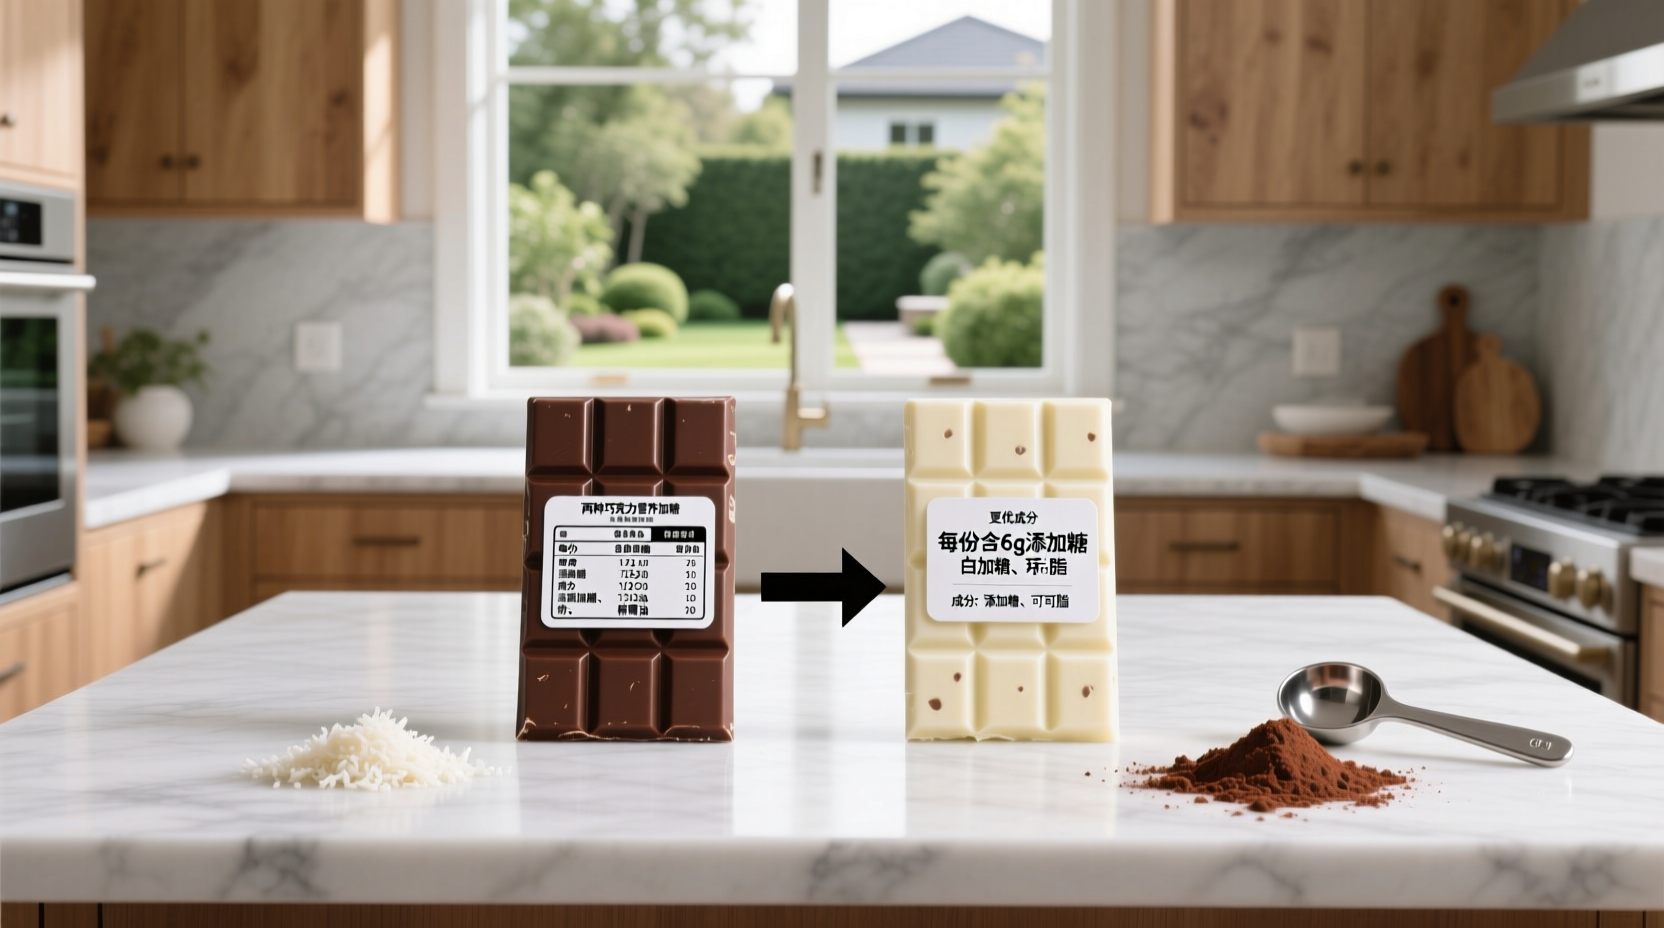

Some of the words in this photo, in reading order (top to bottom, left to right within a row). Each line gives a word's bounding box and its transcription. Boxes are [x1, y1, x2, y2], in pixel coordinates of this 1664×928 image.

[938, 531, 1088, 556] 每份含6g添加糖
